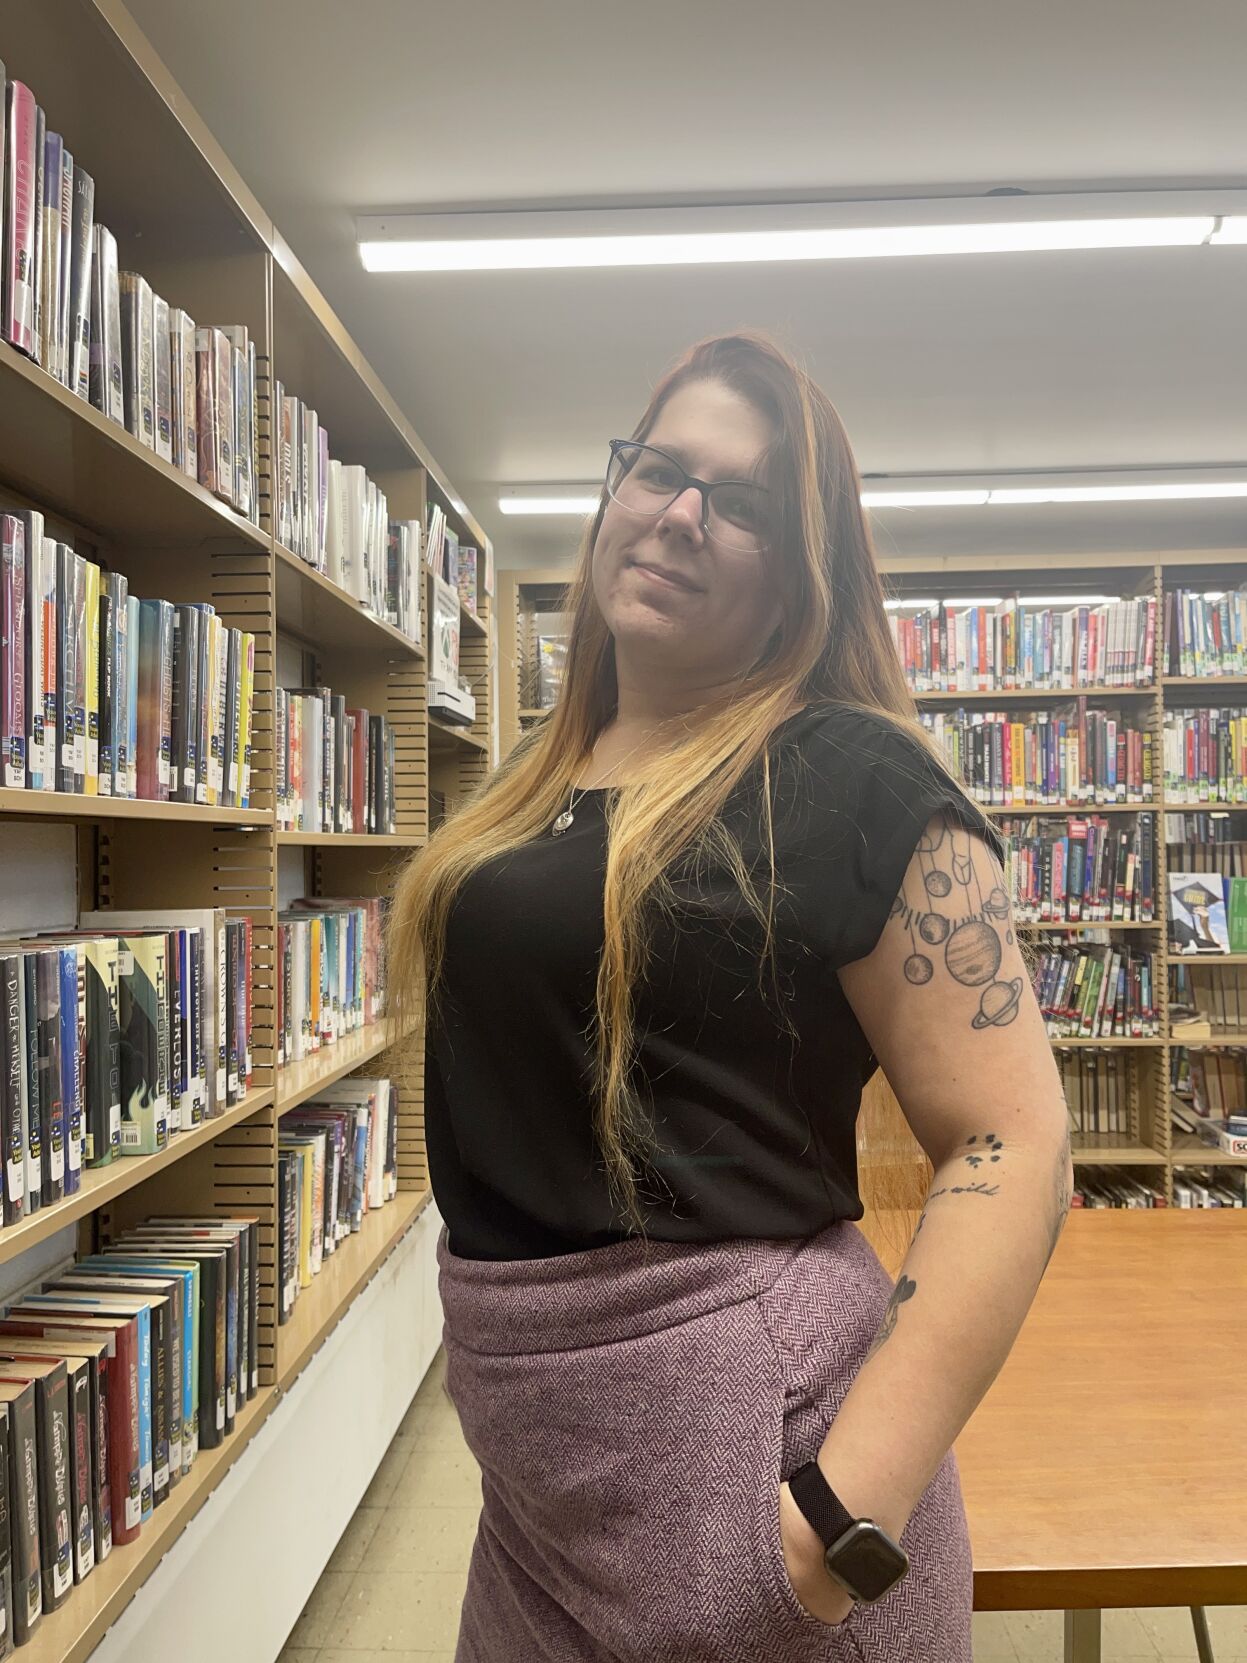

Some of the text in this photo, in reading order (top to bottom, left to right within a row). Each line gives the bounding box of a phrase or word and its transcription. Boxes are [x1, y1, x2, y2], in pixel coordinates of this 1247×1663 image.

[284, 442, 292, 484] IDOLS
[65, 619, 75, 715] ARCHIV
[7, 979, 19, 1034] DANGER
[173, 990, 182, 1081] EVERLOS
[10, 1045, 20, 1089] HERSELF
[30, 1029, 40, 1098] FOLLOW
[12, 1107, 22, 1136] OTHE
[157, 1347, 165, 1388] ALLIES
